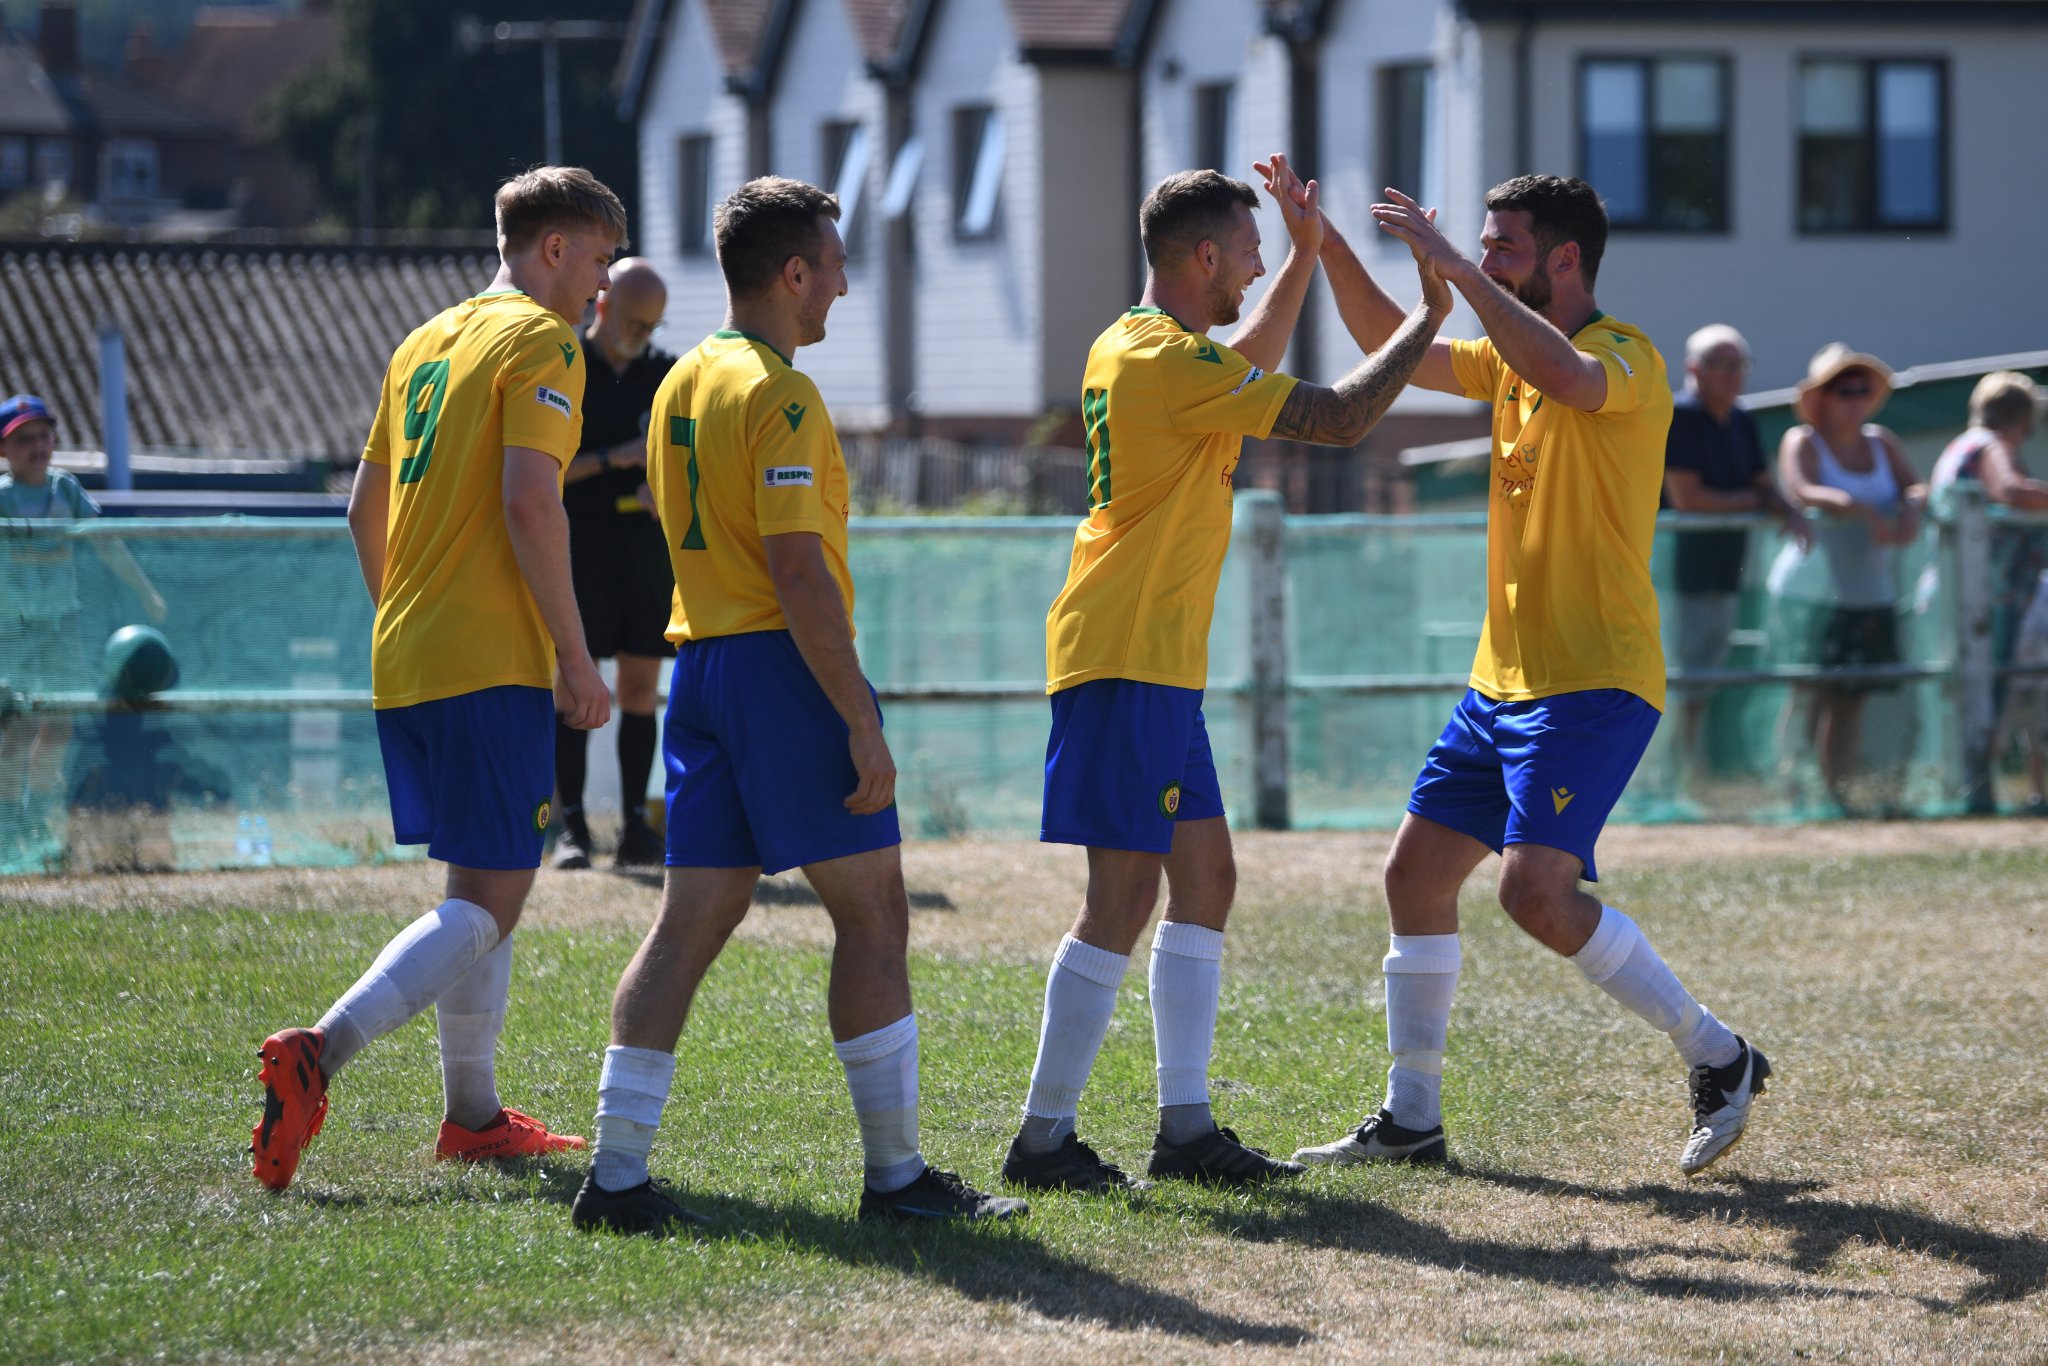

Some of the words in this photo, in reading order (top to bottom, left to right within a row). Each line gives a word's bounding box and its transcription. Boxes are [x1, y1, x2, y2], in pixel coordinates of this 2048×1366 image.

[399, 358, 450, 484] 9
[776, 470, 812, 481] RESPECT
[1083, 388, 1112, 510] 11
[1521, 443, 1537, 464] &
[669, 415, 707, 550] 7
